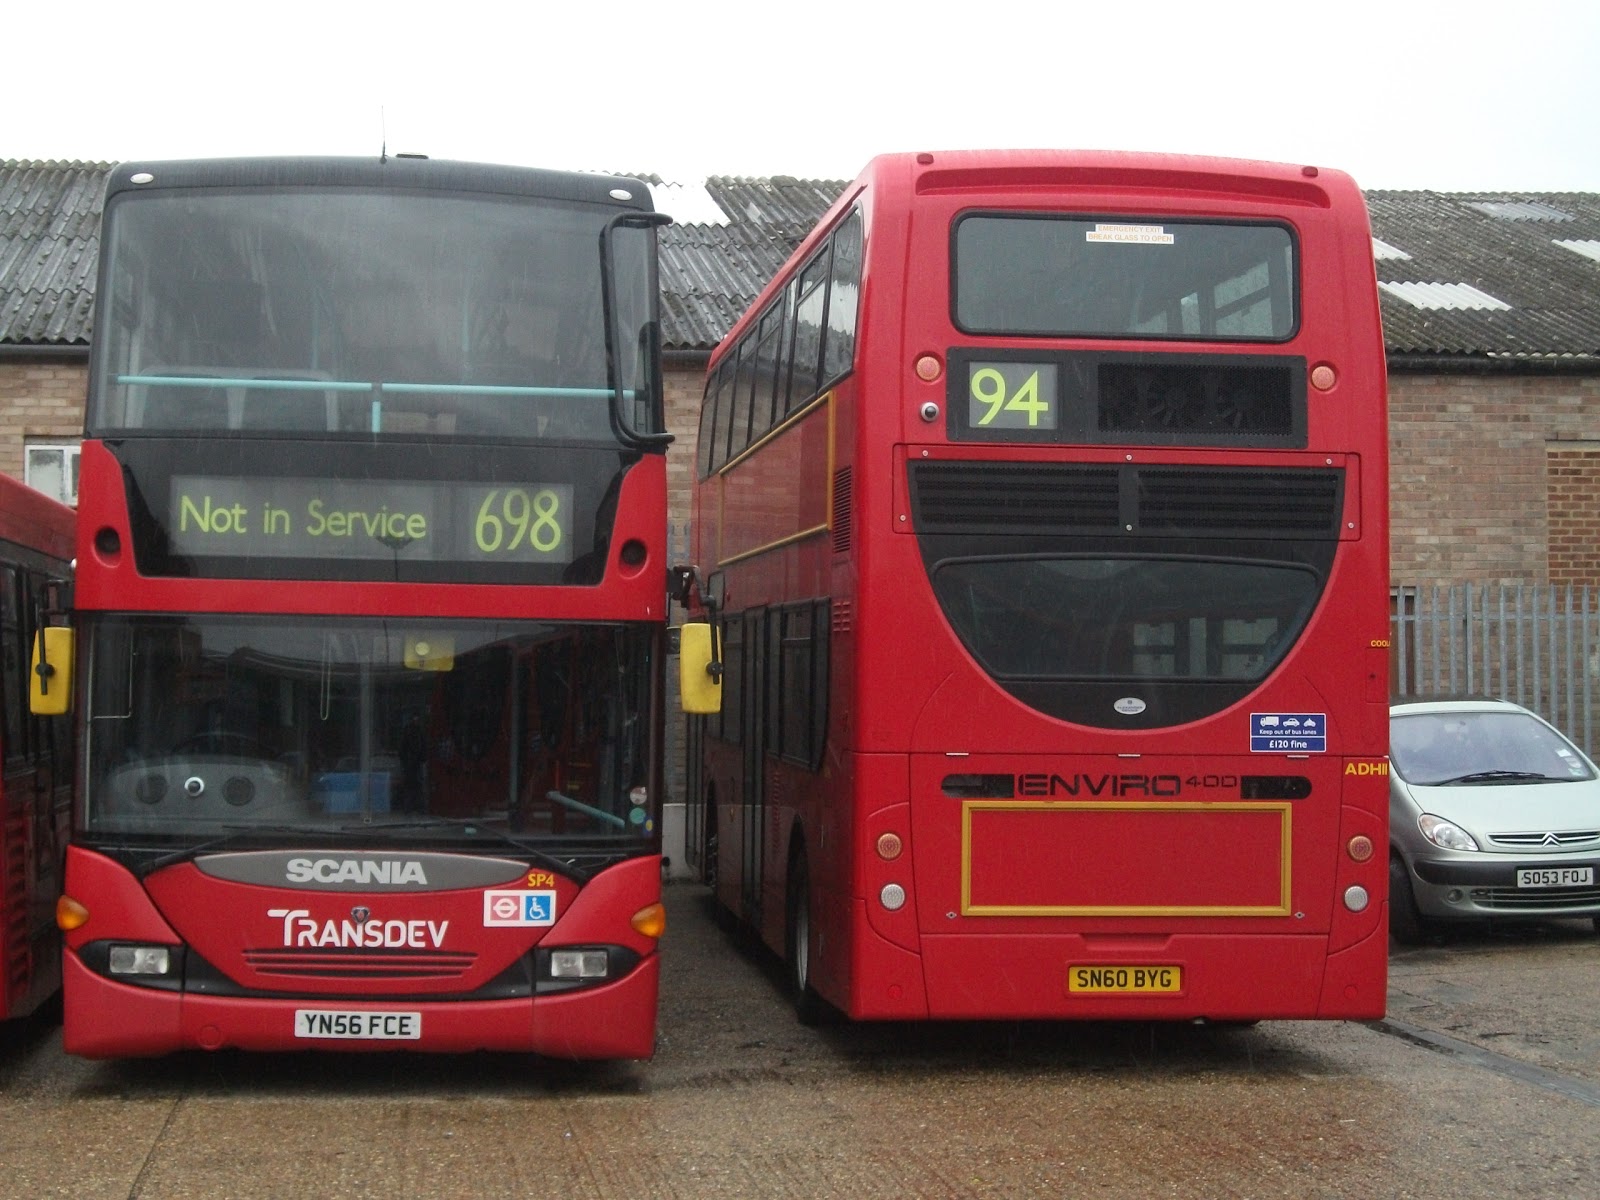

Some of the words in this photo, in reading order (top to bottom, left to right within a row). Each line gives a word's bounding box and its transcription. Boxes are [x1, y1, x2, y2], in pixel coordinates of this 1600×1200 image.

[1098, 225, 1144, 233] EMERGENCY
[971, 368, 1048, 426] 94
[180, 495, 247, 534] Not
[263, 502, 290, 535] in
[306, 499, 426, 539] Service
[475, 488, 561, 552] 698
[1269, 740, 1288, 748] £120
[1290, 740, 1308, 748] fine
[1018, 773, 1181, 796] ENVIRO
[1185, 775, 1237, 788] 400
[285, 858, 428, 885] SCANIA
[527, 873, 555, 887] SP4
[1523, 870, 1559, 885] SO53
[1562, 869, 1588, 883] FOJ
[267, 909, 449, 948] TRANSDEV
[1077, 969, 1128, 988] SN60
[1134, 969, 1172, 988] BYG
[305, 1013, 362, 1035] YN56
[369, 1015, 412, 1036] FCE
